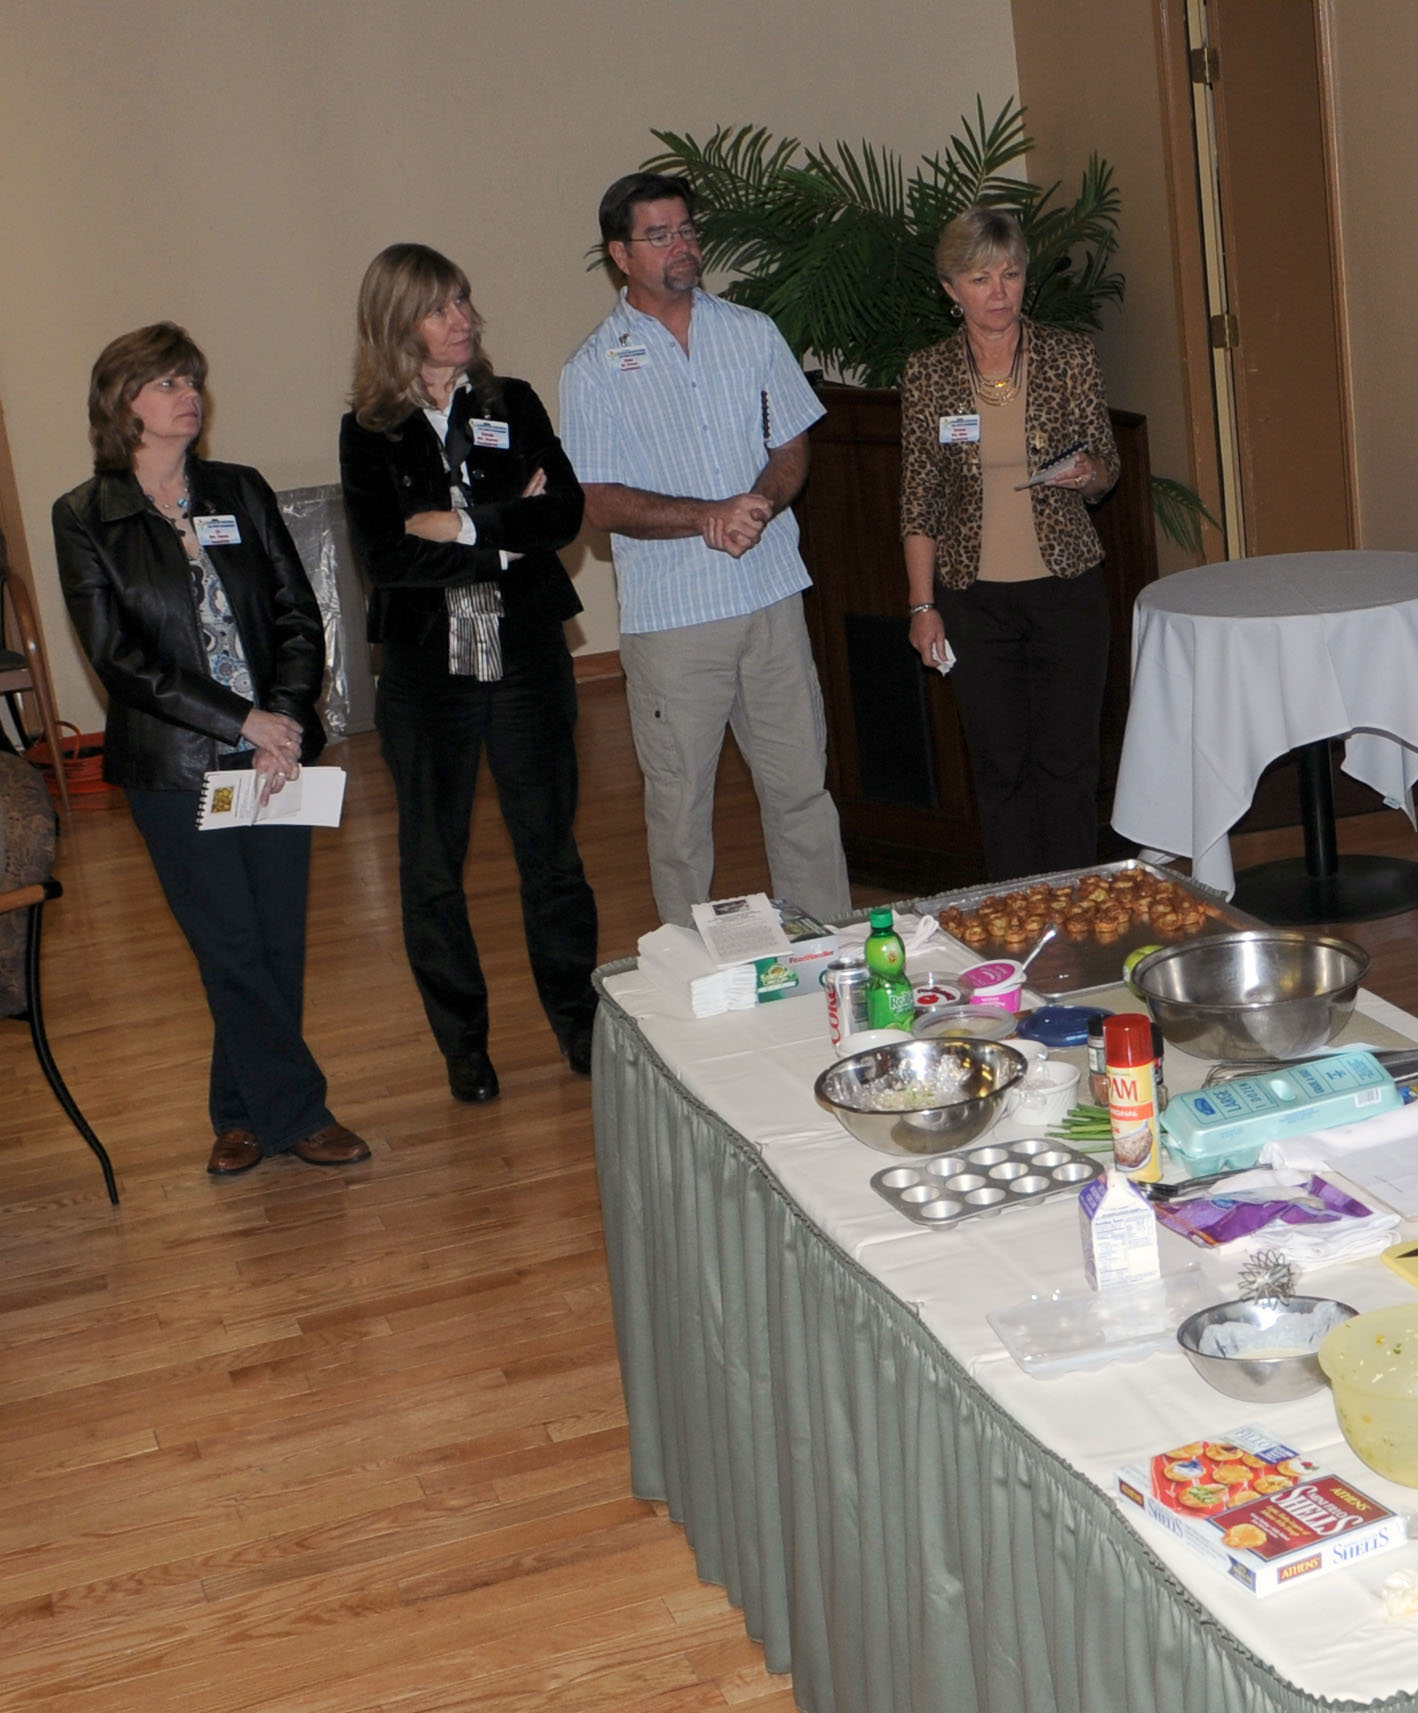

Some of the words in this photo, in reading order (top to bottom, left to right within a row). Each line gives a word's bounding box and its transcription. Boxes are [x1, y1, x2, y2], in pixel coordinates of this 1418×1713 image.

[1270, 1485, 1364, 1536] SHELLS
[1330, 1488, 1371, 1511] ATHENS
[1333, 1527, 1389, 1564] SHELLS
[1281, 1558, 1318, 1580] ATHENS
